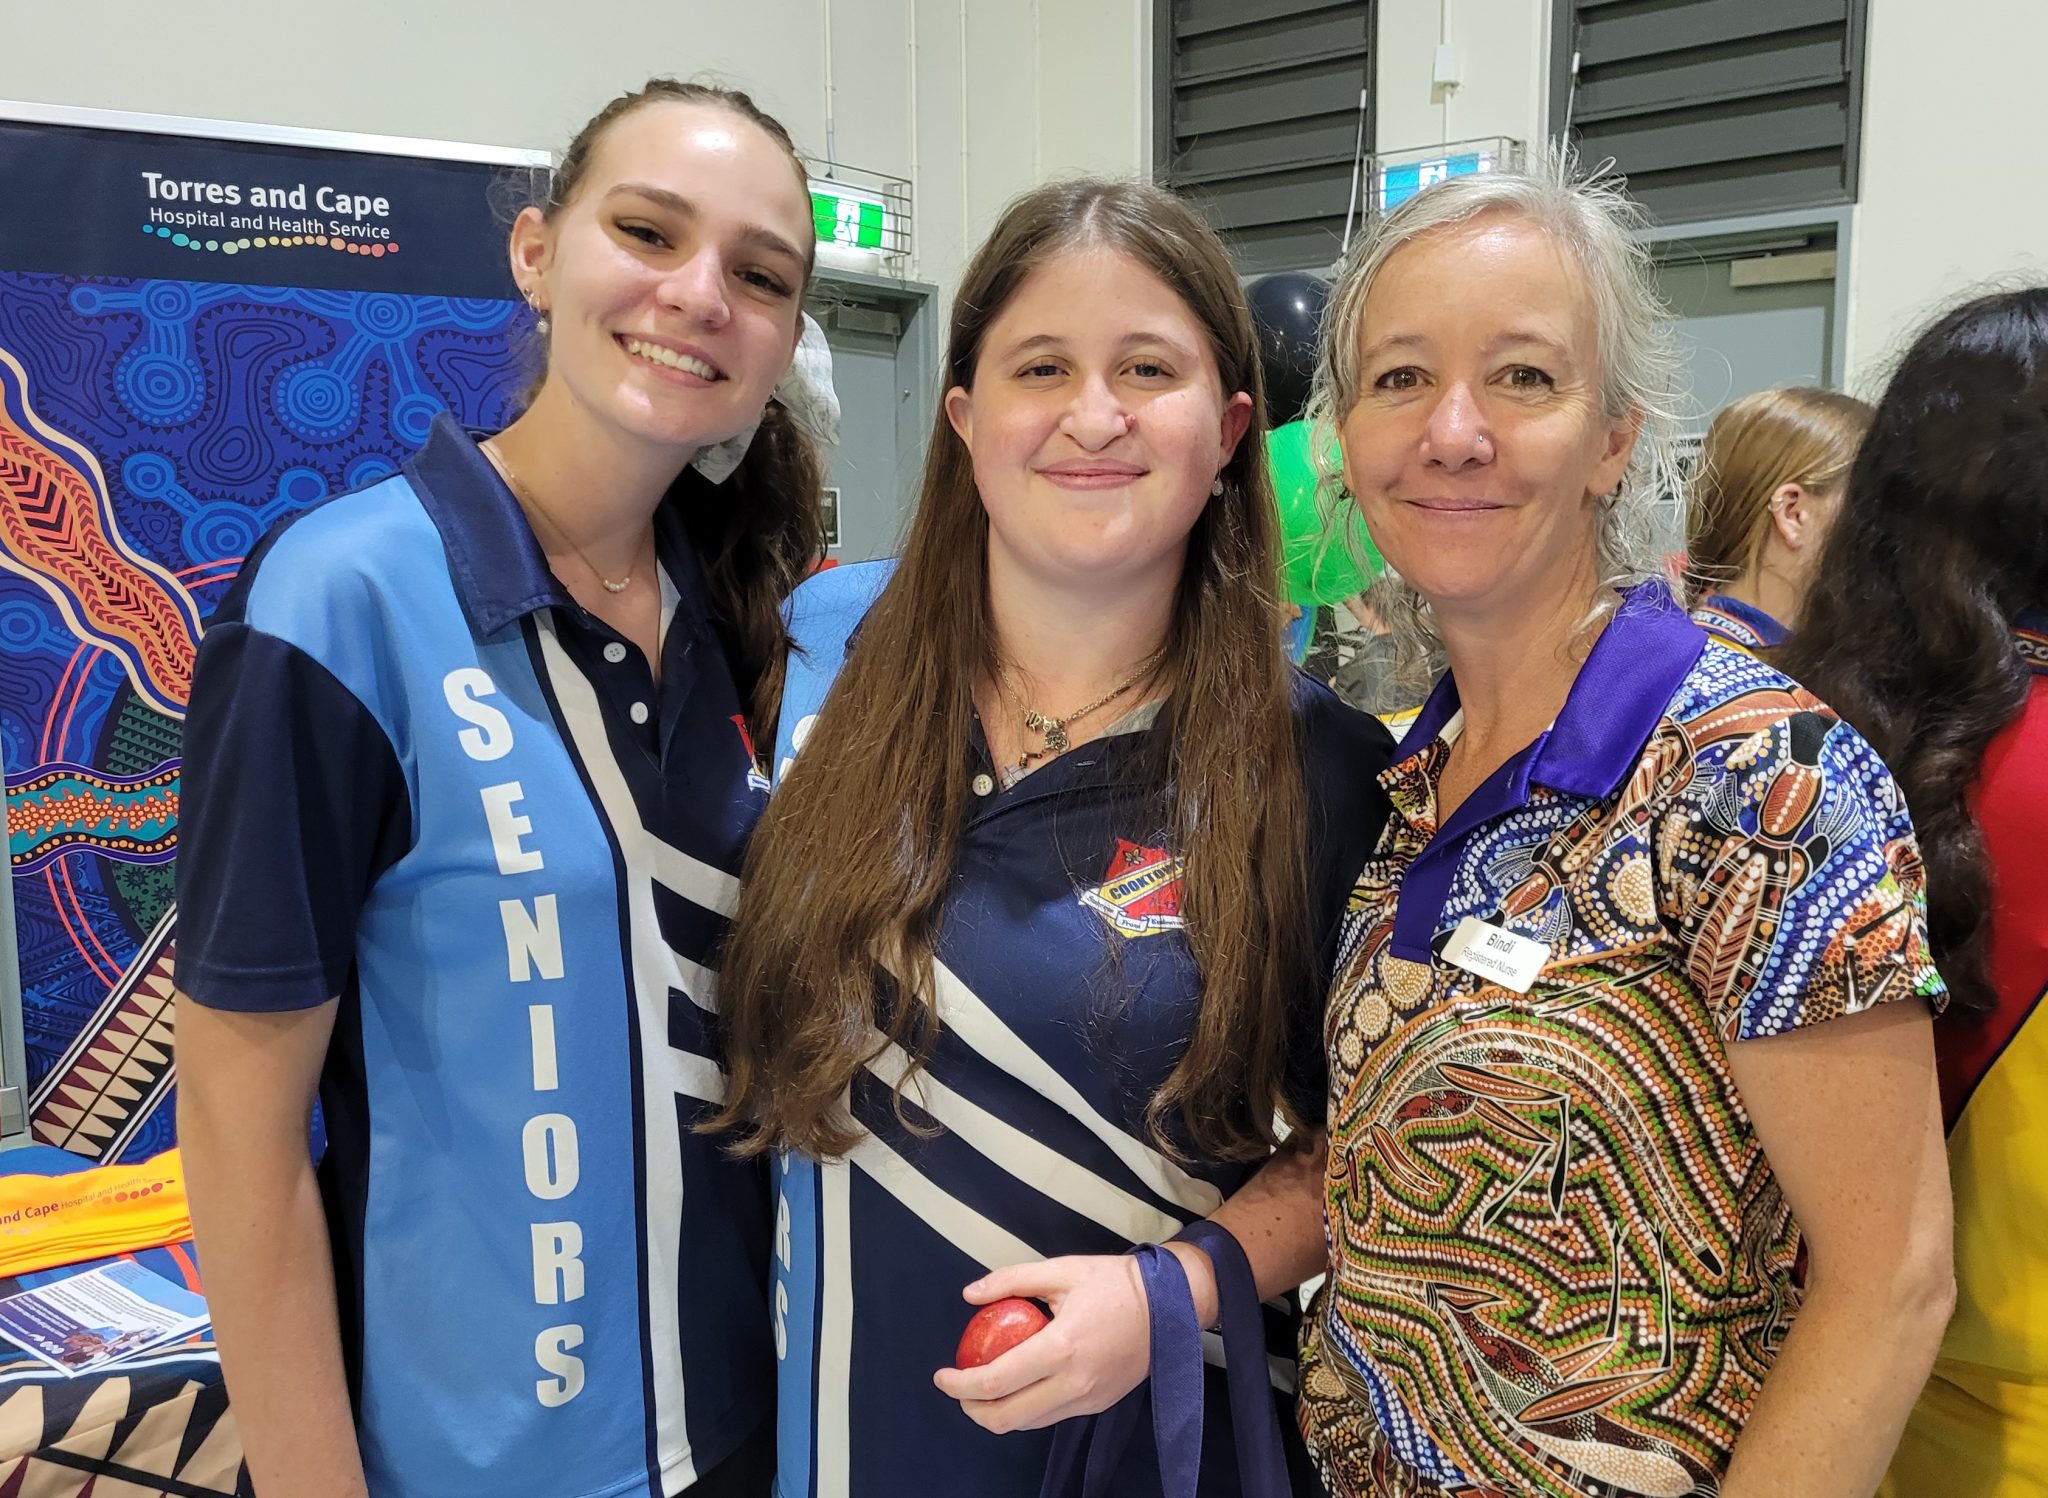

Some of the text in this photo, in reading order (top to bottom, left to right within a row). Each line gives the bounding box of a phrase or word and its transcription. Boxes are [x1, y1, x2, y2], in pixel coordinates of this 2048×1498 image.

[142, 171, 390, 221] Torres and Cape
[150, 207, 391, 240] Hospital and Health Service
[1486, 932, 1517, 955] Bindi
[1462, 946, 1518, 977] Registered Nurse
[443, 667, 586, 1408] SENIORS
[0, 1210, 21, 1225] nd
[25, 1202, 59, 1218] Cape
[61, 1193, 95, 1210] Hospital
[97, 1187, 113, 1199] and
